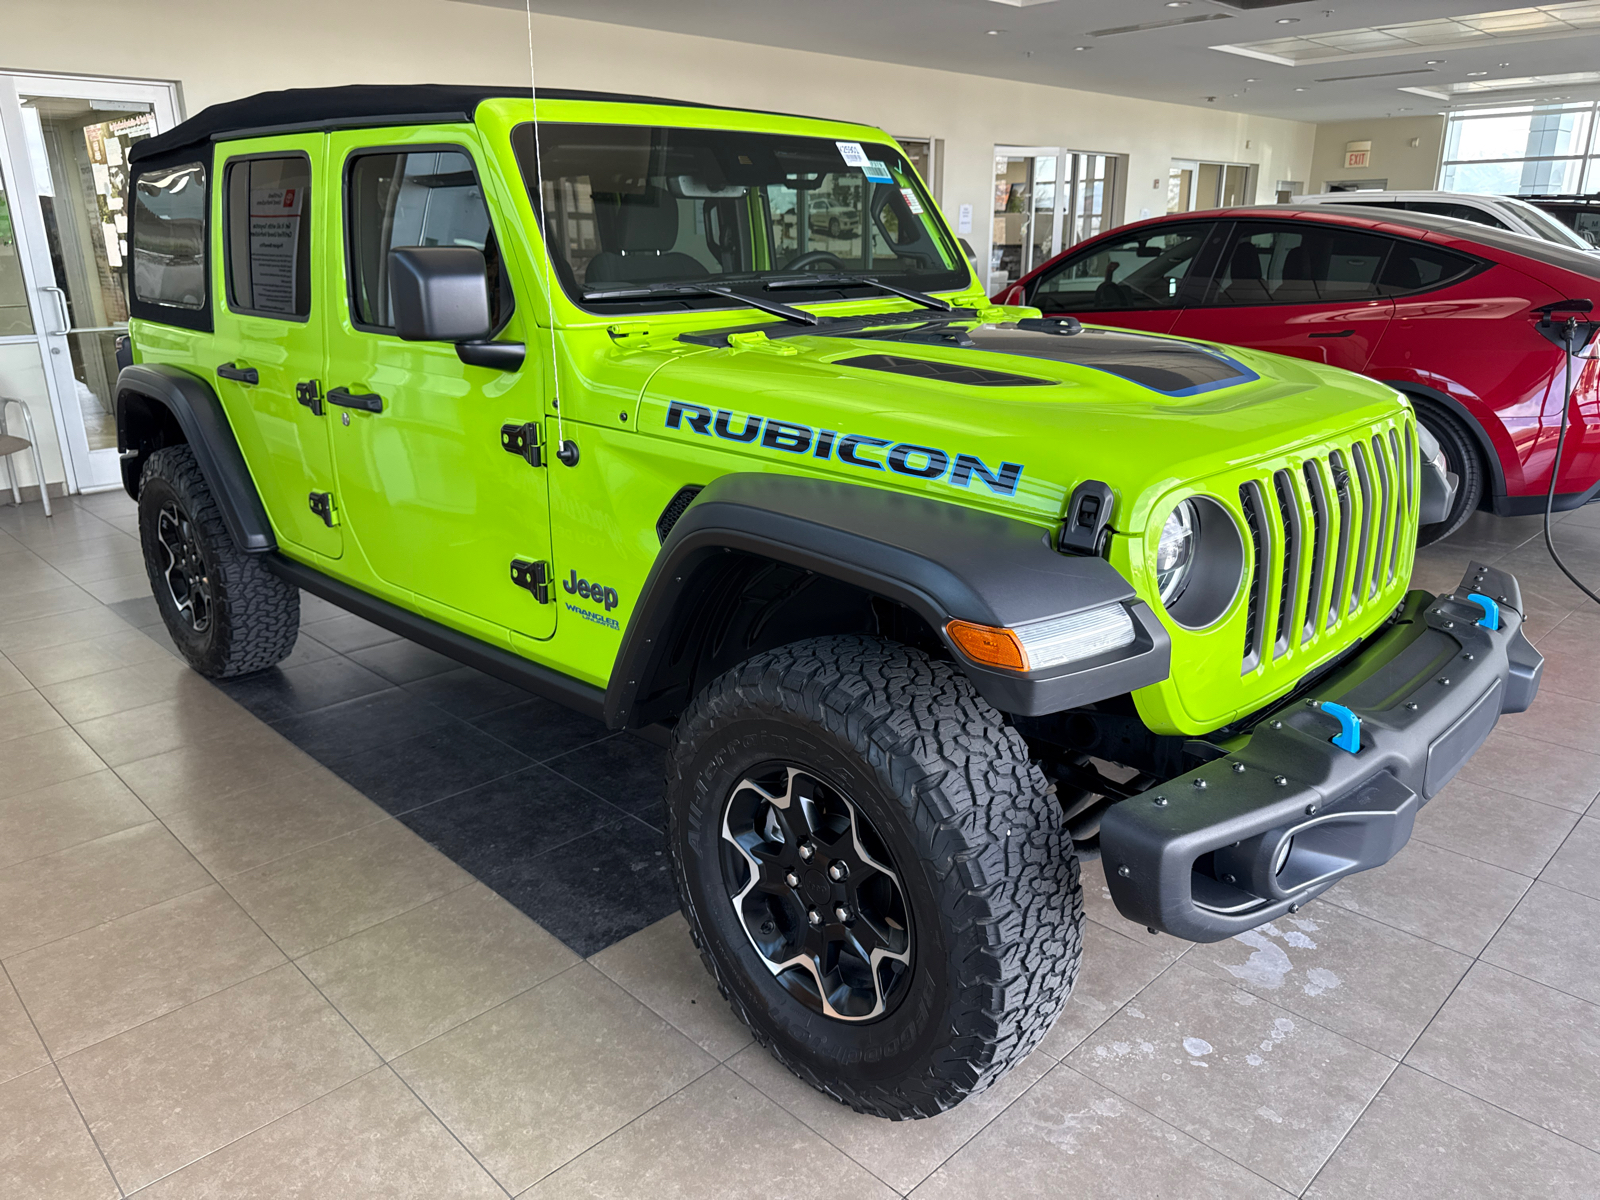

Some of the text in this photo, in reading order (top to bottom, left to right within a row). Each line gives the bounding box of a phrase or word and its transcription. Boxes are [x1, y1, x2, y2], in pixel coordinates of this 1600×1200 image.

[1349, 153, 1365, 165] EXIT
[665, 400, 1024, 496] RUBICON
[563, 569, 618, 612] Jeep
[565, 602, 619, 627] WRANGLER
